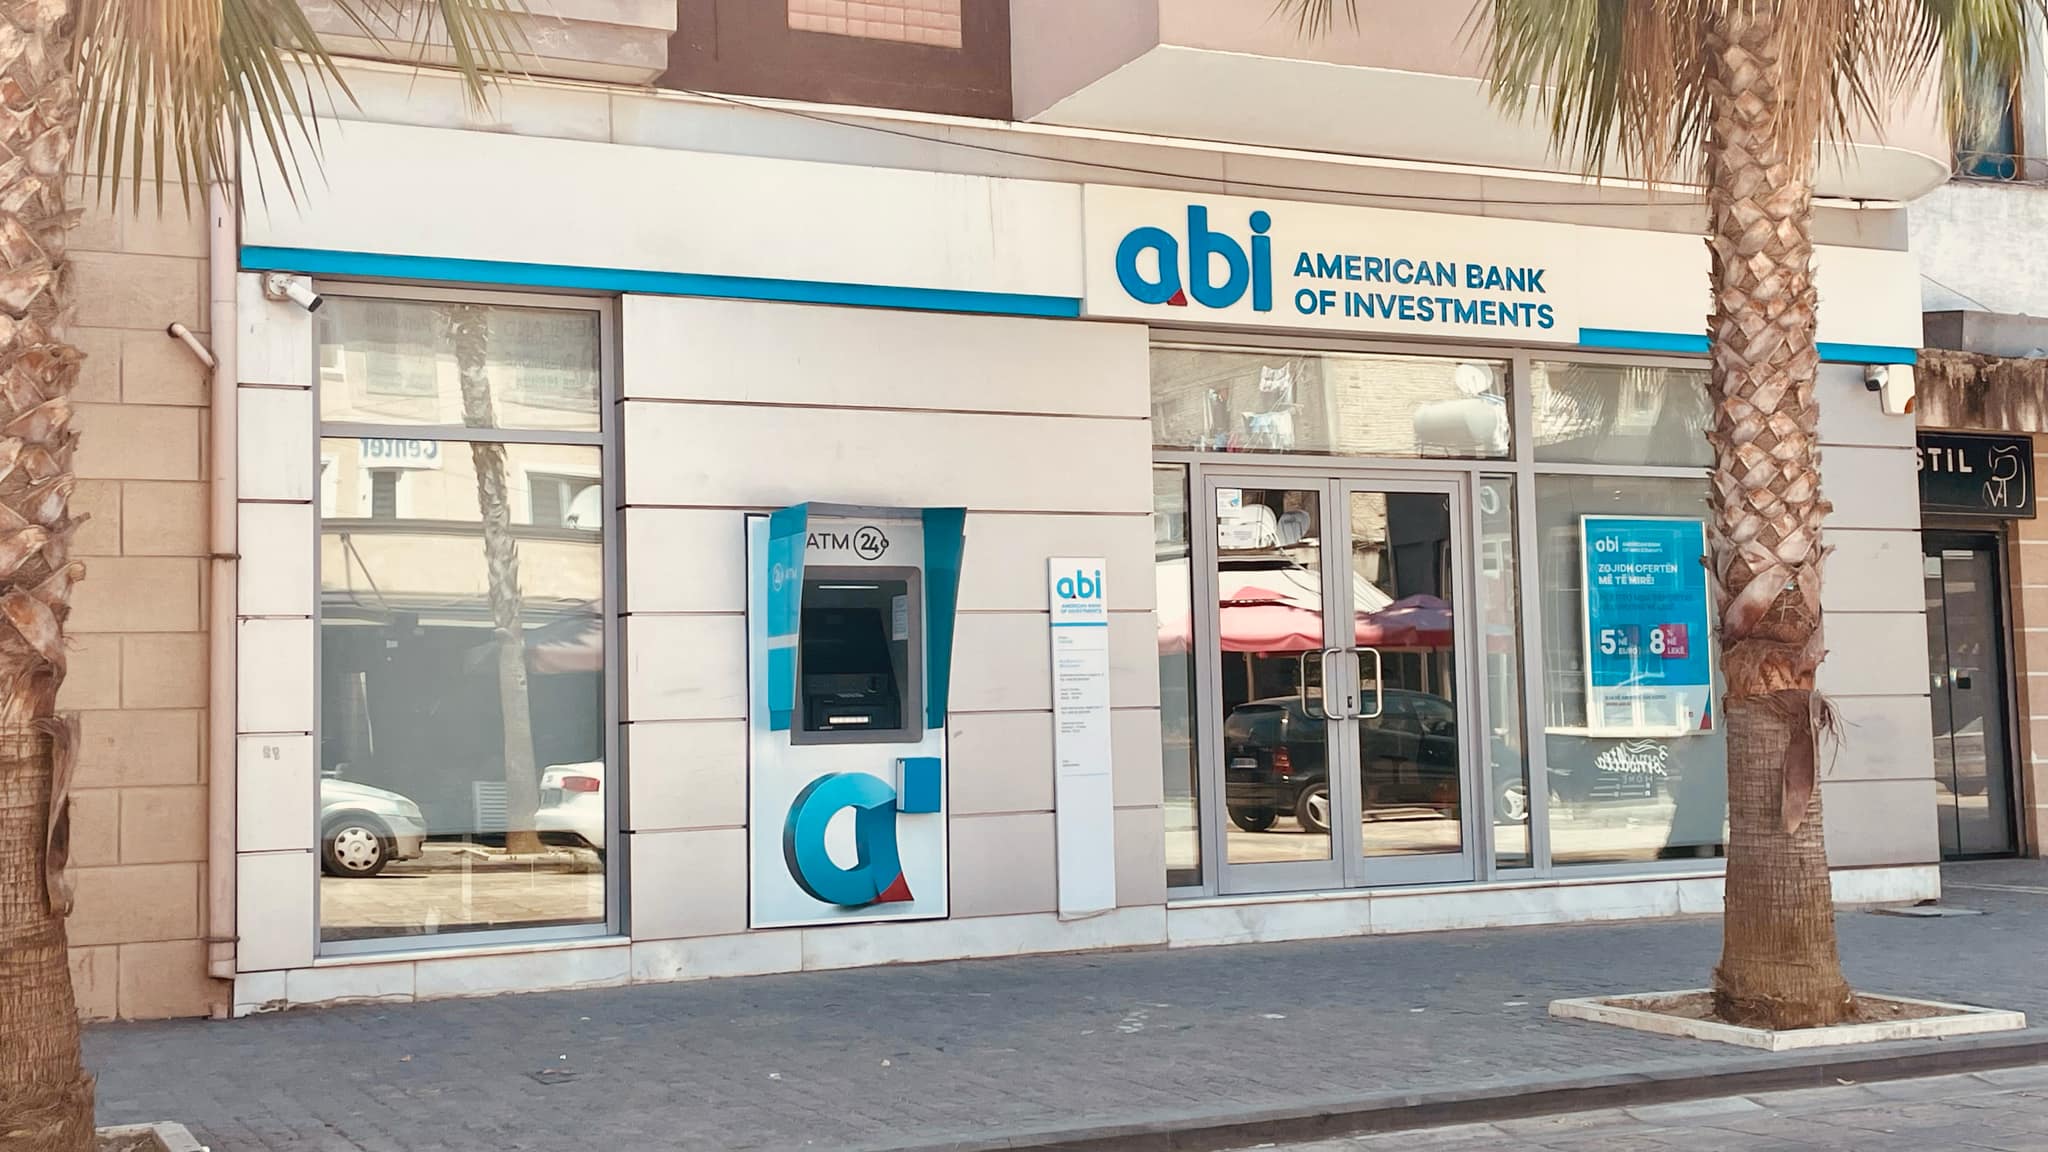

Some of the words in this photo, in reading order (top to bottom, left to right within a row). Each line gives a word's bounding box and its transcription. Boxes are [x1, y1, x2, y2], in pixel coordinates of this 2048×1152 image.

[1115, 204, 1273, 313] abi
[1293, 251, 1457, 288] AMERICAN
[1465, 263, 1547, 294] BANK
[1294, 287, 1337, 317] OF
[1344, 291, 1555, 330] INVESTMENTS
[806, 532, 850, 550] ATM
[860, 533, 880, 554] 24
[1056, 569, 1102, 599] abi
[1600, 629, 1617, 655] 5
[1649, 628, 1666, 655] 8
